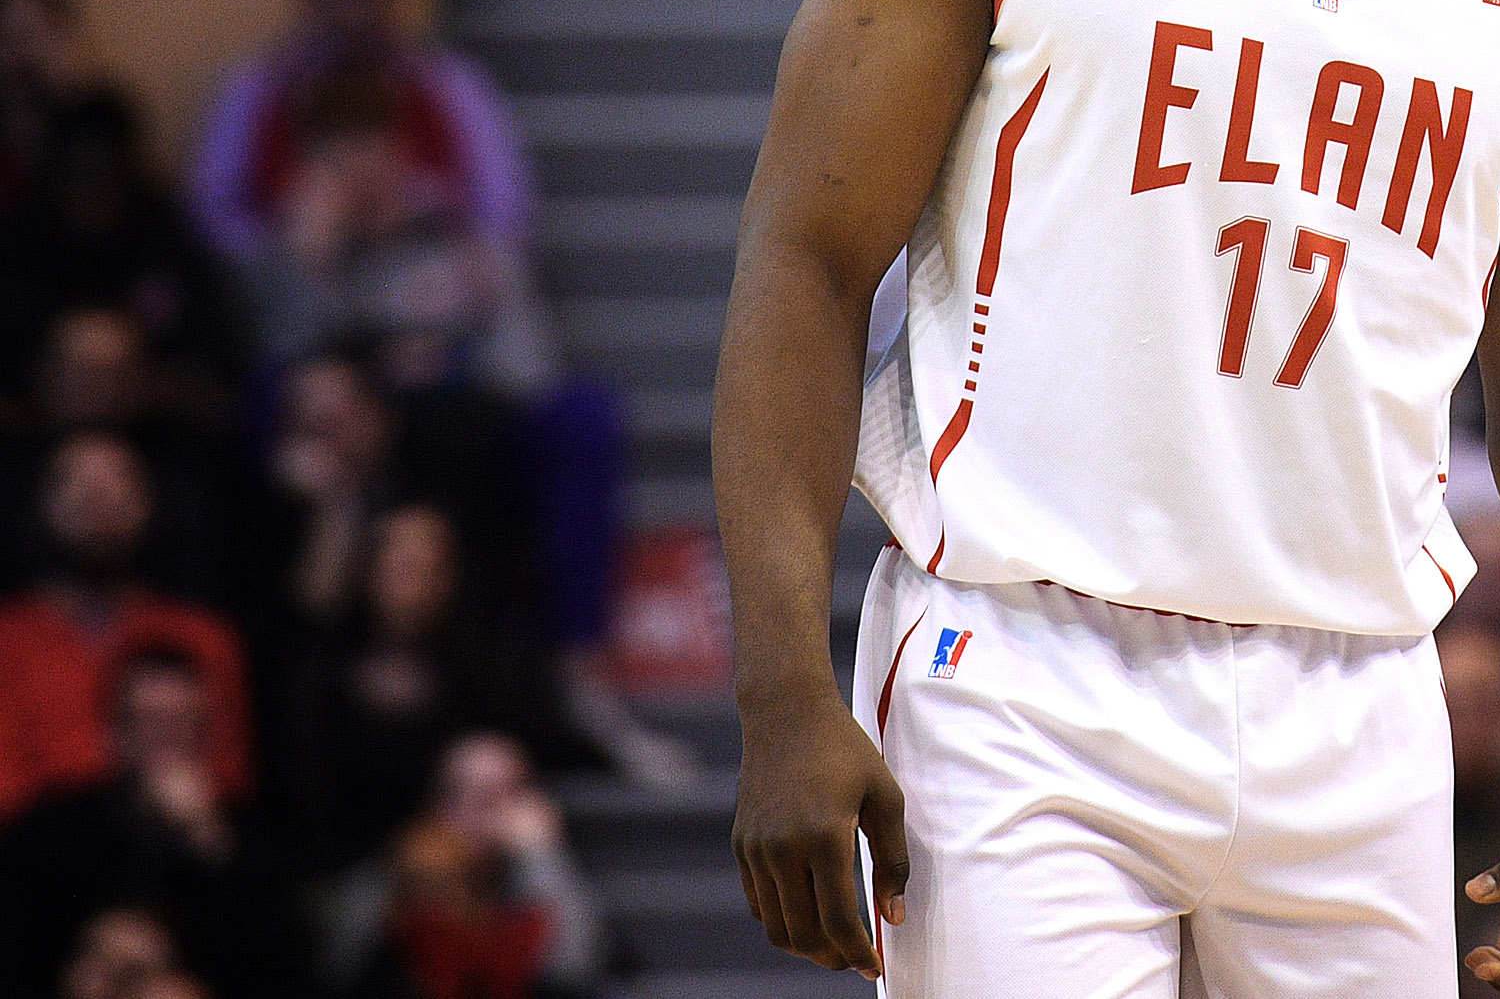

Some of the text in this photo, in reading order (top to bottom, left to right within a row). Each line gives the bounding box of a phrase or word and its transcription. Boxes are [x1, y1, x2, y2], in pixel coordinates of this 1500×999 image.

[1131, 20, 1474, 260] ELAN
[1214, 214, 1350, 390] 17
[929, 663, 956, 678] LNB
